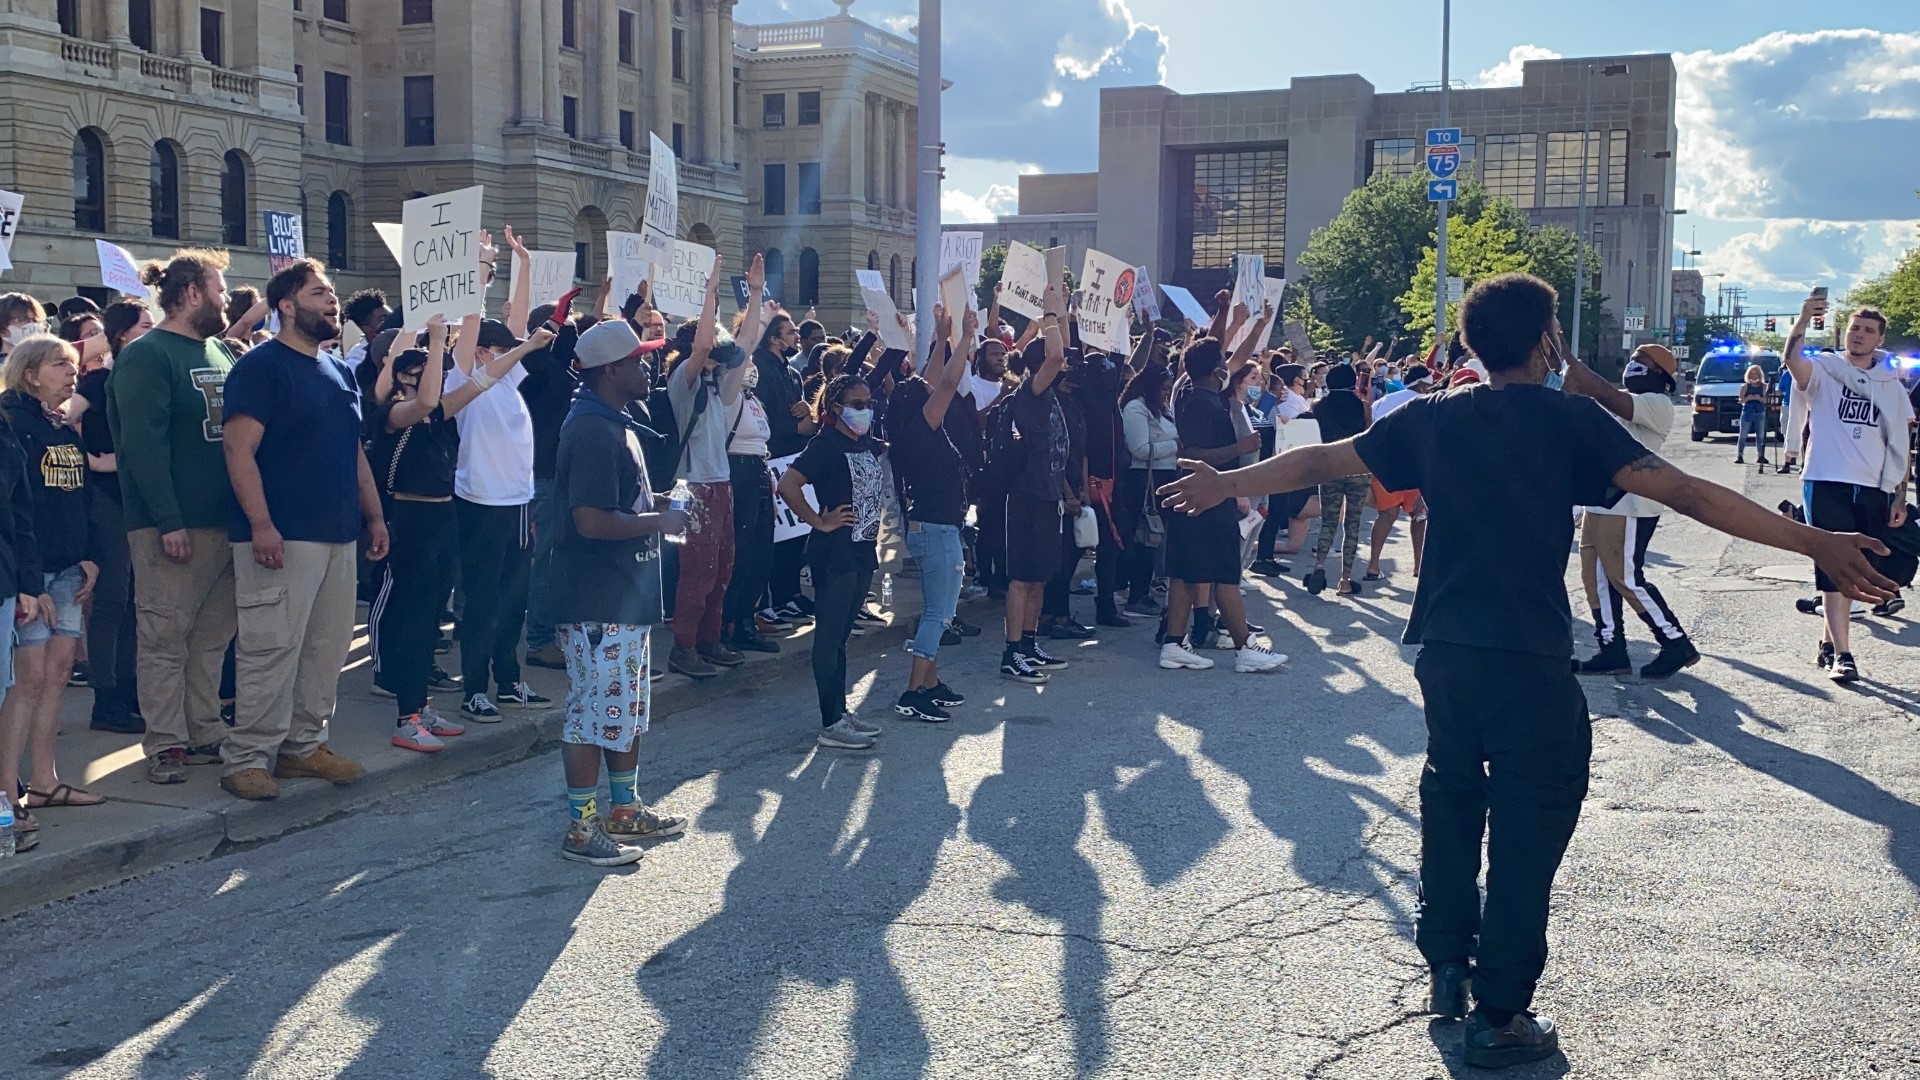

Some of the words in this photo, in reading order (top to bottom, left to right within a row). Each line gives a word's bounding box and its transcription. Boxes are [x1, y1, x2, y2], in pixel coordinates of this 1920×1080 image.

[1436, 132, 1451, 142] TO
[1432, 156, 1455, 171] 75
[271, 214, 297, 238] BLUE
[431, 202, 451, 227] I
[413, 229, 473, 266] CAN'T
[674, 248, 698, 268] END
[955, 235, 982, 259] RIOT
[531, 258, 564, 286] LACK
[662, 266, 707, 287] POLICE
[409, 270, 476, 311] BREATHE
[653, 281, 706, 306] BRUTALI
[739, 280, 771, 297] BLK
[1838, 397, 1880, 424] VISION
